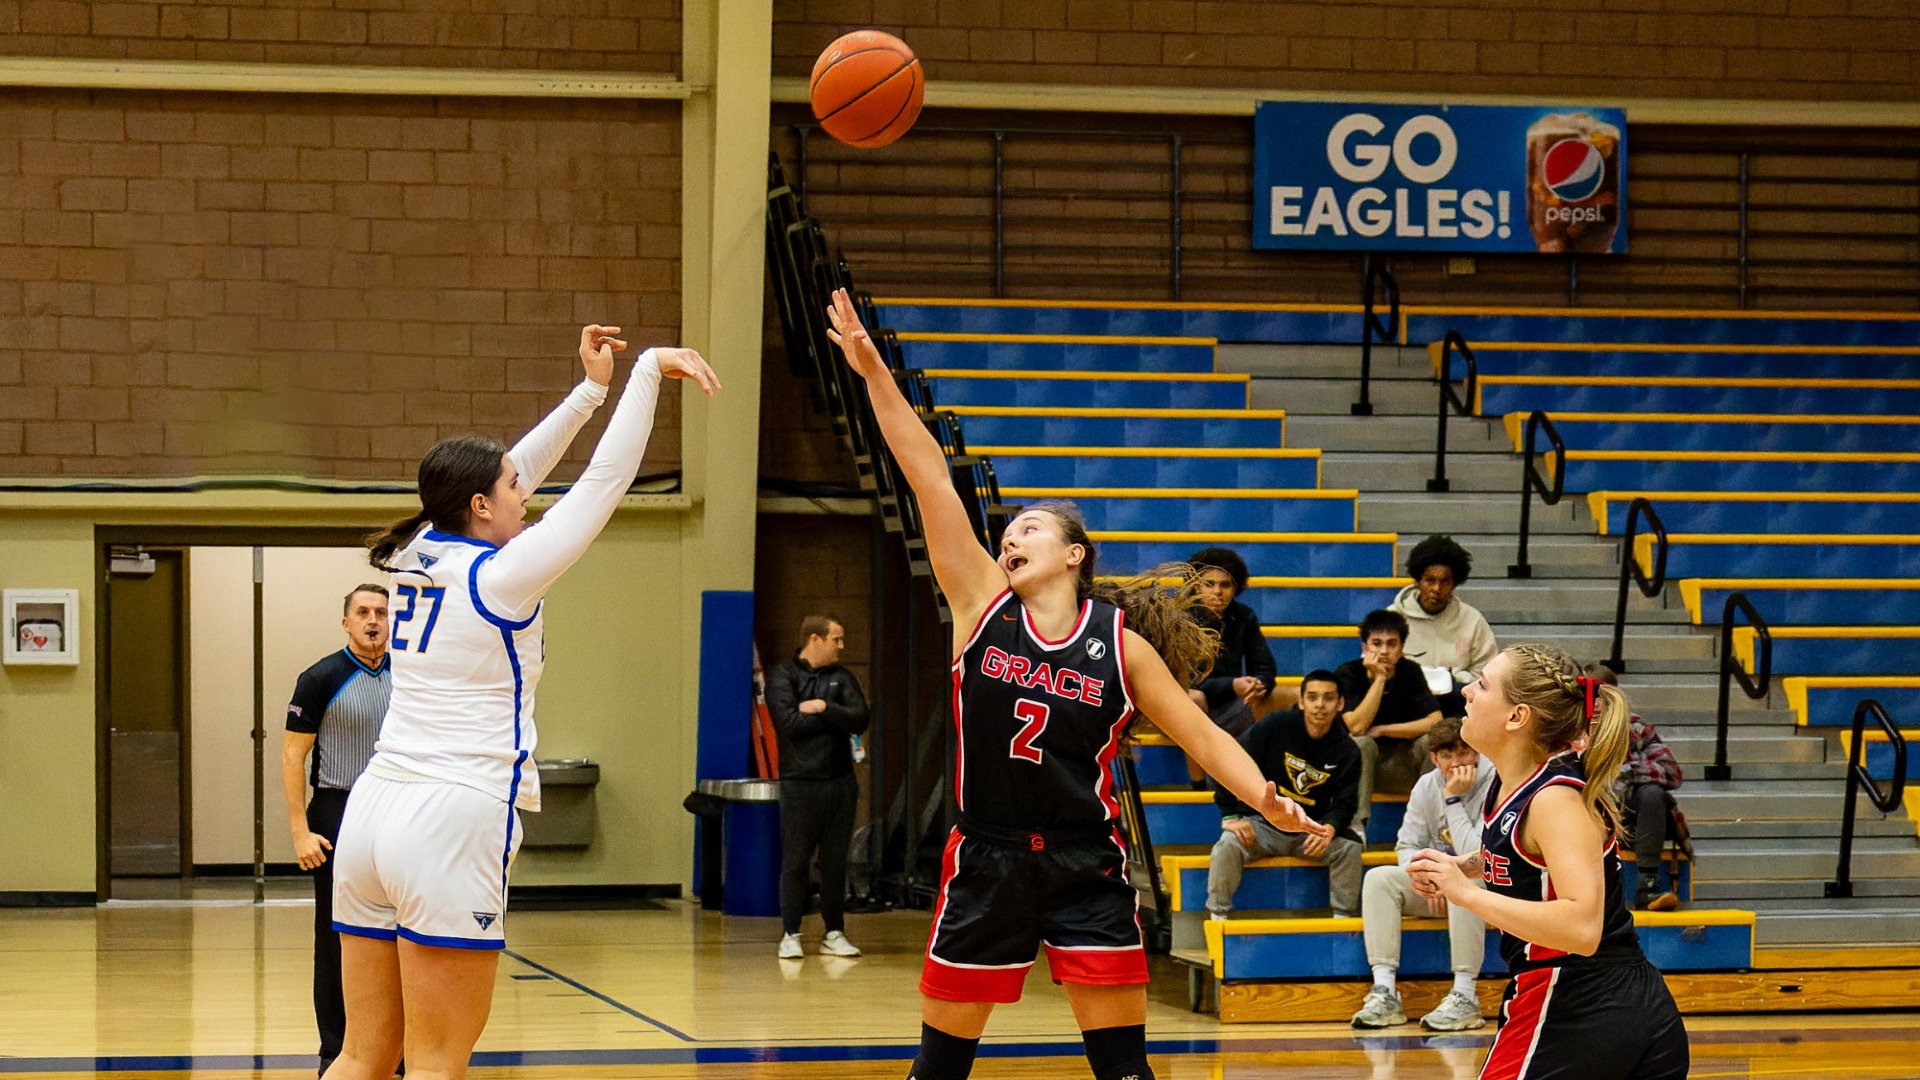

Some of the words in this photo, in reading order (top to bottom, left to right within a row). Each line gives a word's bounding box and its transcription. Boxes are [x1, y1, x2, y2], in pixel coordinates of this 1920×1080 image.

[1327, 113, 1458, 184] GO
[1270, 186, 1511, 239] EAGLES!
[1545, 204, 1601, 225] pepsi
[391, 582, 447, 654] 27
[981, 645, 1104, 707] GRACE
[1009, 698, 1050, 765] 2
